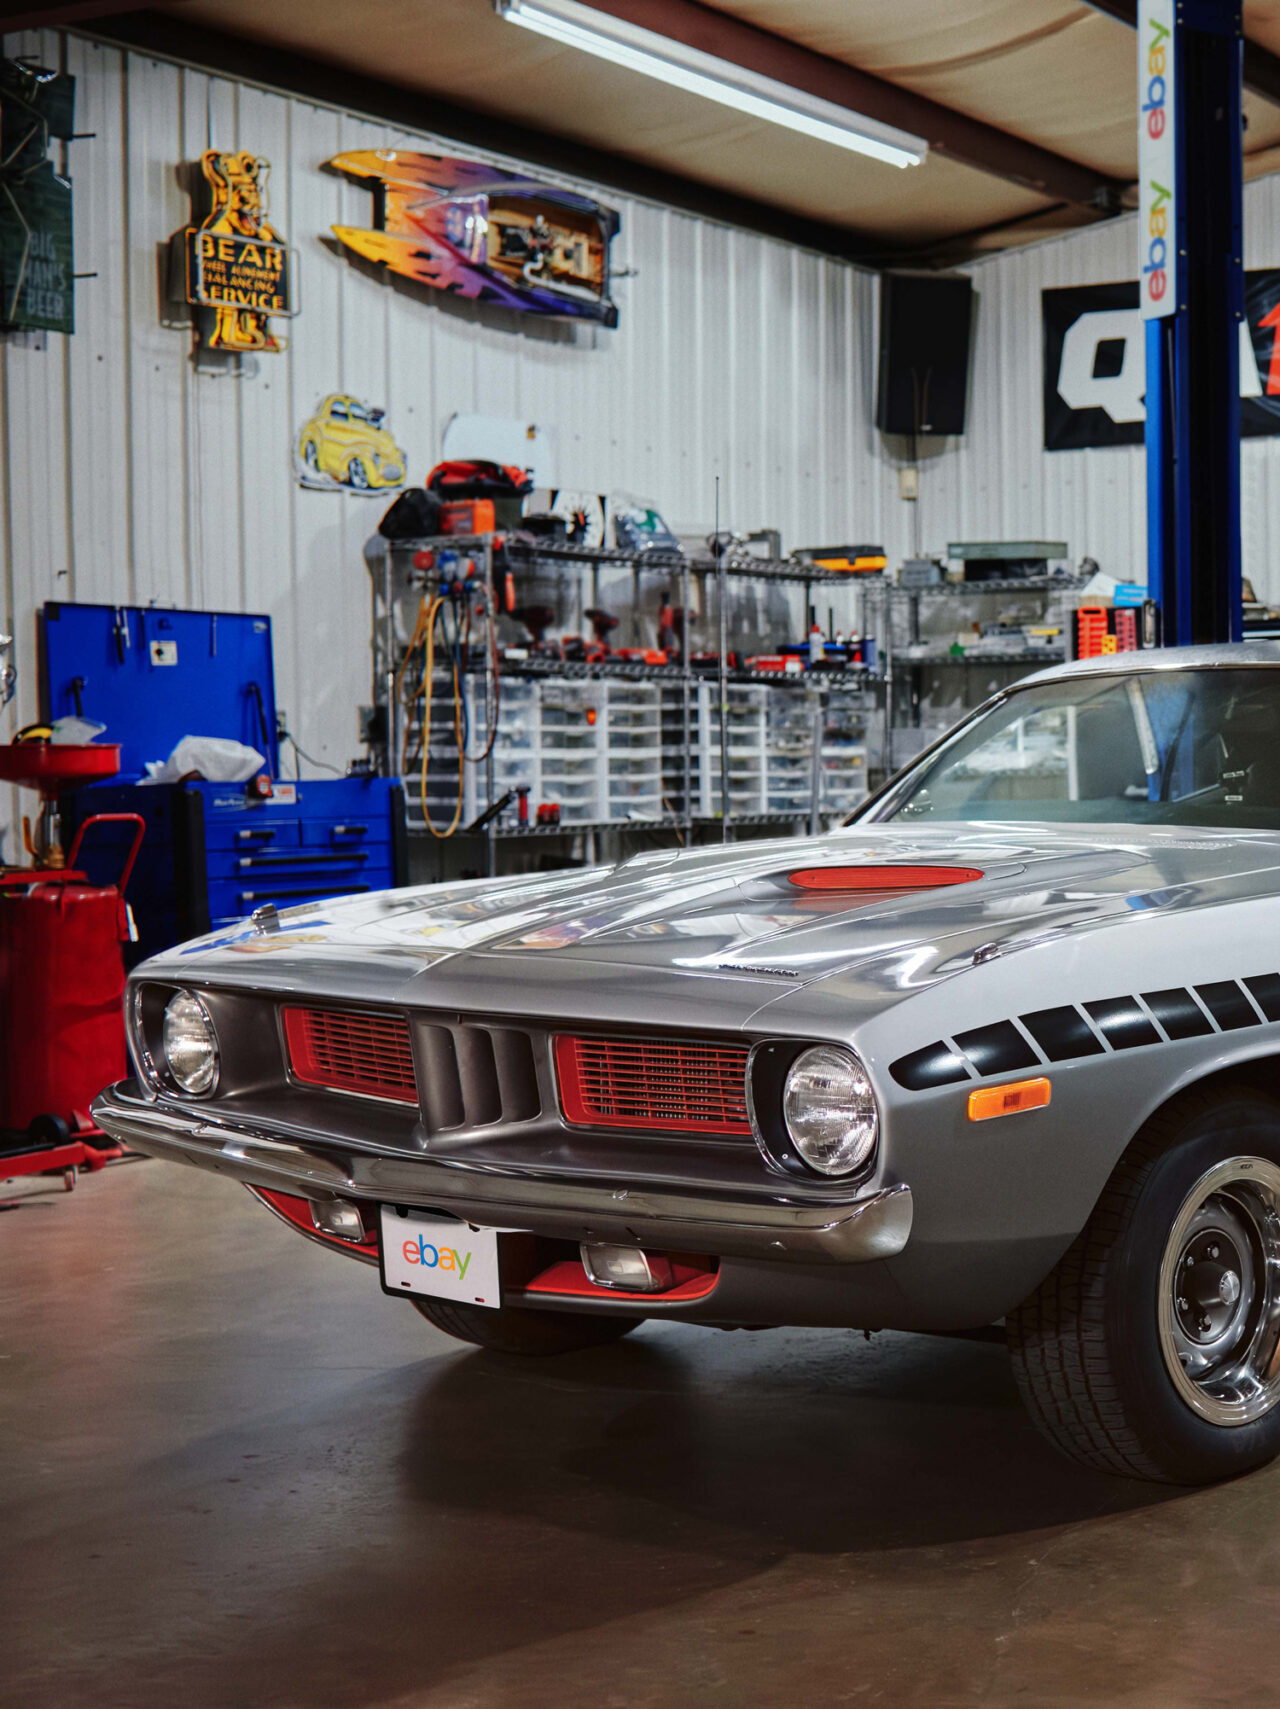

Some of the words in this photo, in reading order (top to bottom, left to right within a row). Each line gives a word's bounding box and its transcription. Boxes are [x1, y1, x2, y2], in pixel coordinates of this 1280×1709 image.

[1142, 18, 1171, 140] ebay
[195, 234, 283, 271] BEAR
[1143, 180, 1172, 302] ebay
[402, 1233, 472, 1280] ebay
